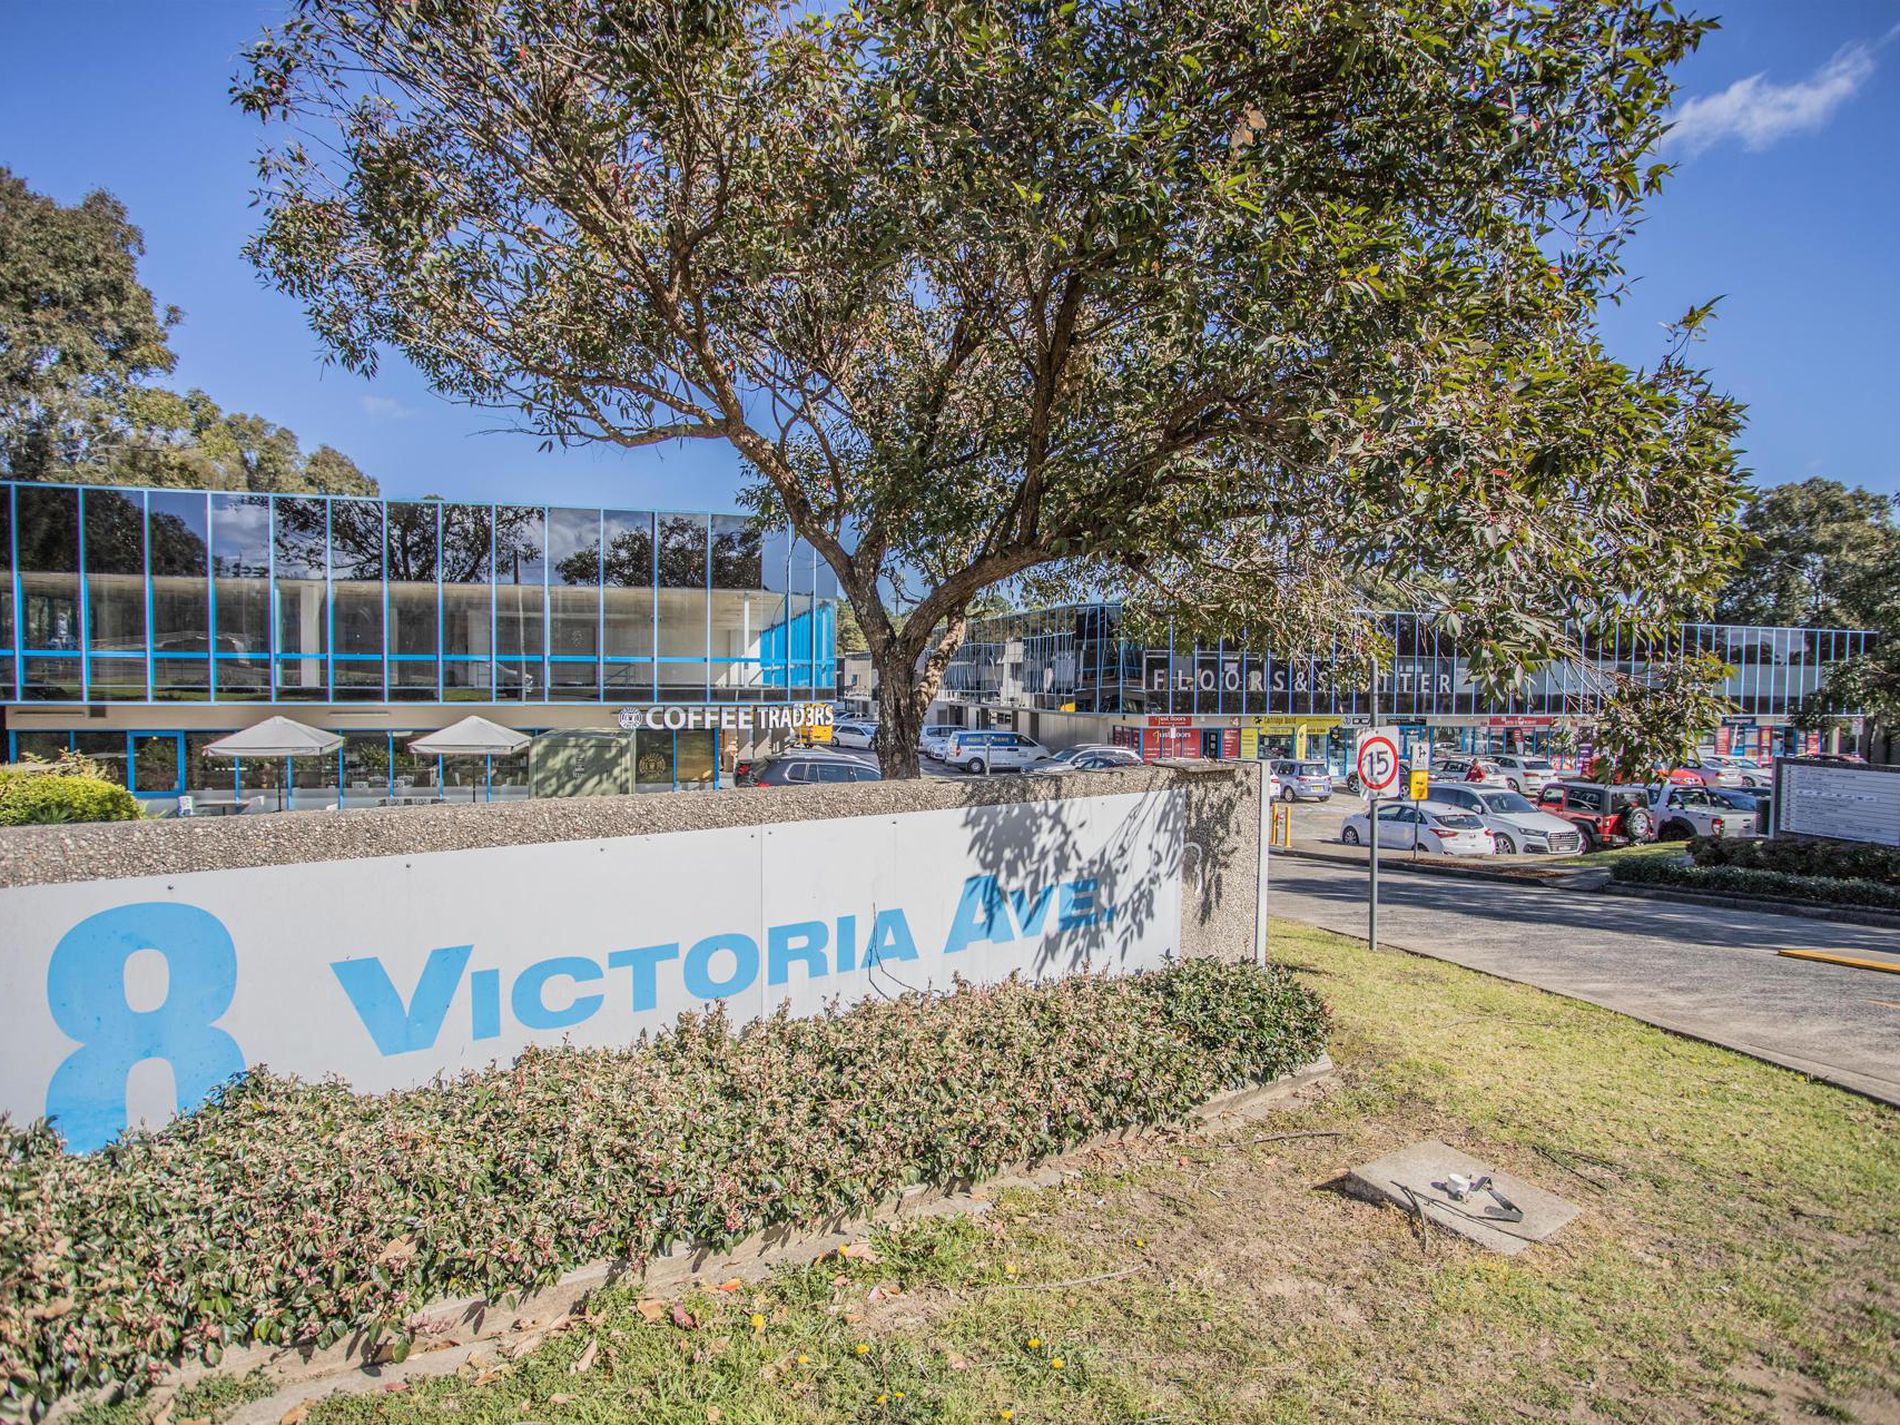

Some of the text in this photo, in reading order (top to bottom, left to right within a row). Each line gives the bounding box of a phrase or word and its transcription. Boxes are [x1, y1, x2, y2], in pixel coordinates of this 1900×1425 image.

[1153, 669, 1286, 691] FLOORS
[645, 706, 753, 730] COFFEE
[1368, 750, 1389, 776] 15
[46, 901, 247, 1155] 8
[330, 907, 919, 1057] VICTORIA
